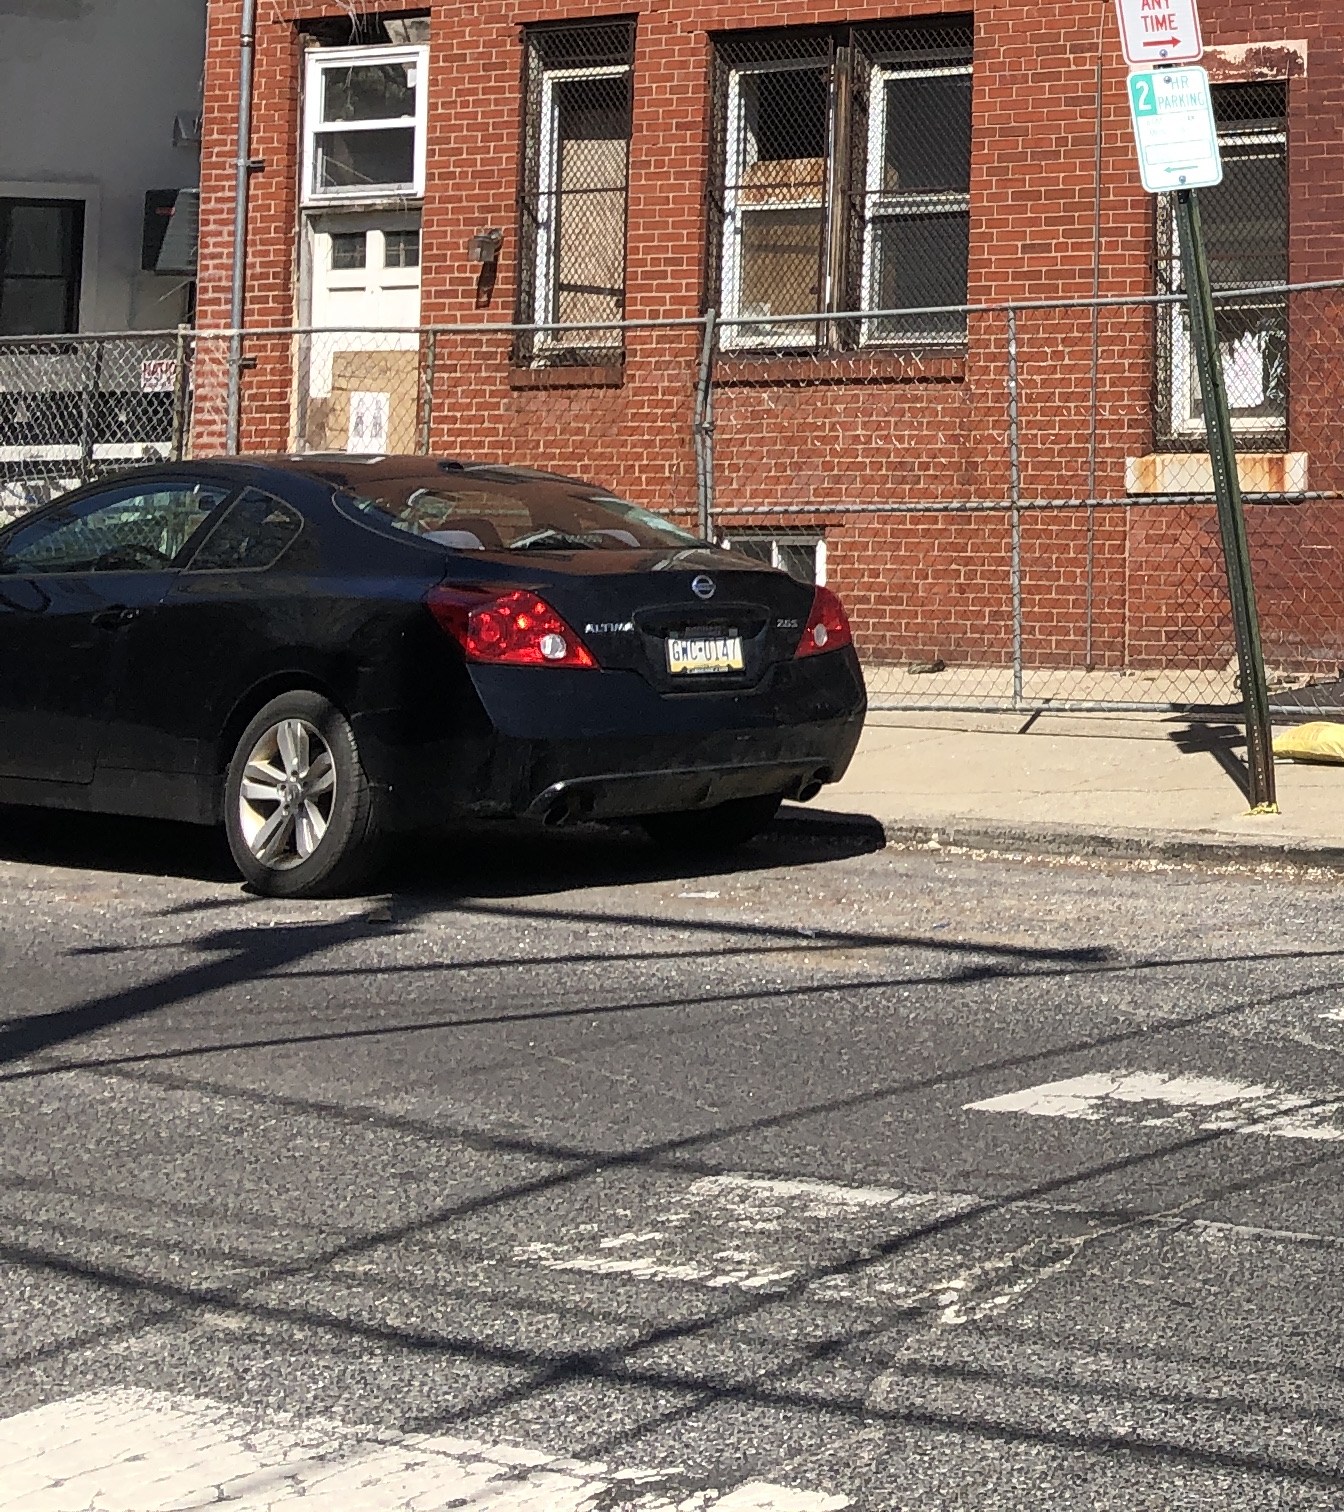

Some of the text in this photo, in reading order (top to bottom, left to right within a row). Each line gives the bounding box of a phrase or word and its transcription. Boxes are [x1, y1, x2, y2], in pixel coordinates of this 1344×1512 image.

[1141, 13, 1178, 32] TIME
[1136, 76, 1189, 110] 2 HR
[1158, 92, 1205, 110] PARKING
[585, 621, 634, 634] ALTIMA
